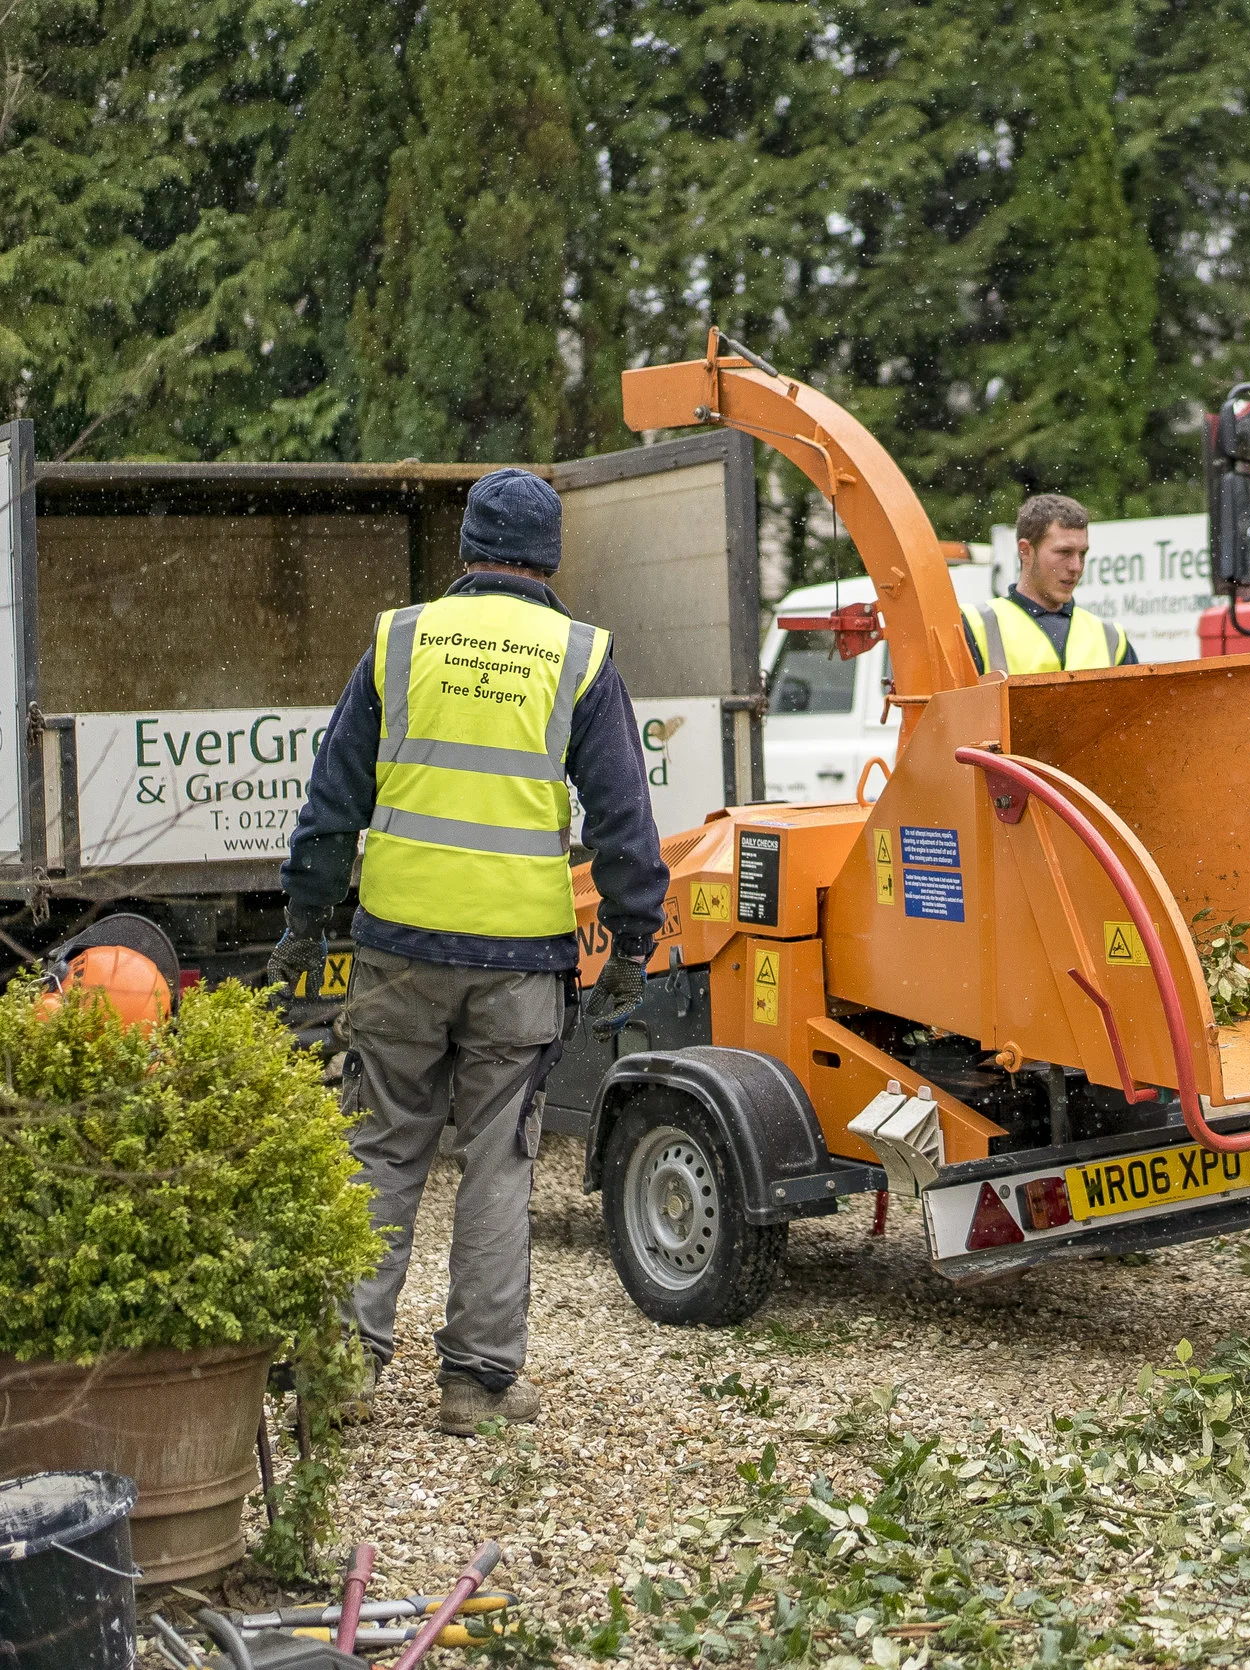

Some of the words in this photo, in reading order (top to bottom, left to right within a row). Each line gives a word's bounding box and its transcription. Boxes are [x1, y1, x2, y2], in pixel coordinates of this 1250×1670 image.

[420, 633, 497, 651] EverGreen
[502, 640, 561, 664] Services
[444, 653, 531, 679] Landscaping
[480, 673, 490, 685] &
[441, 681, 469, 697] Tree
[474, 686, 527, 707] Surgery
[136, 775, 166, 804] &
[185, 773, 310, 802] Groun
[210, 810, 230, 830] T:
[741, 837, 756, 847] DAILY
[757, 839, 778, 849] CHECKS
[1081, 1156, 1171, 1208] WR06
